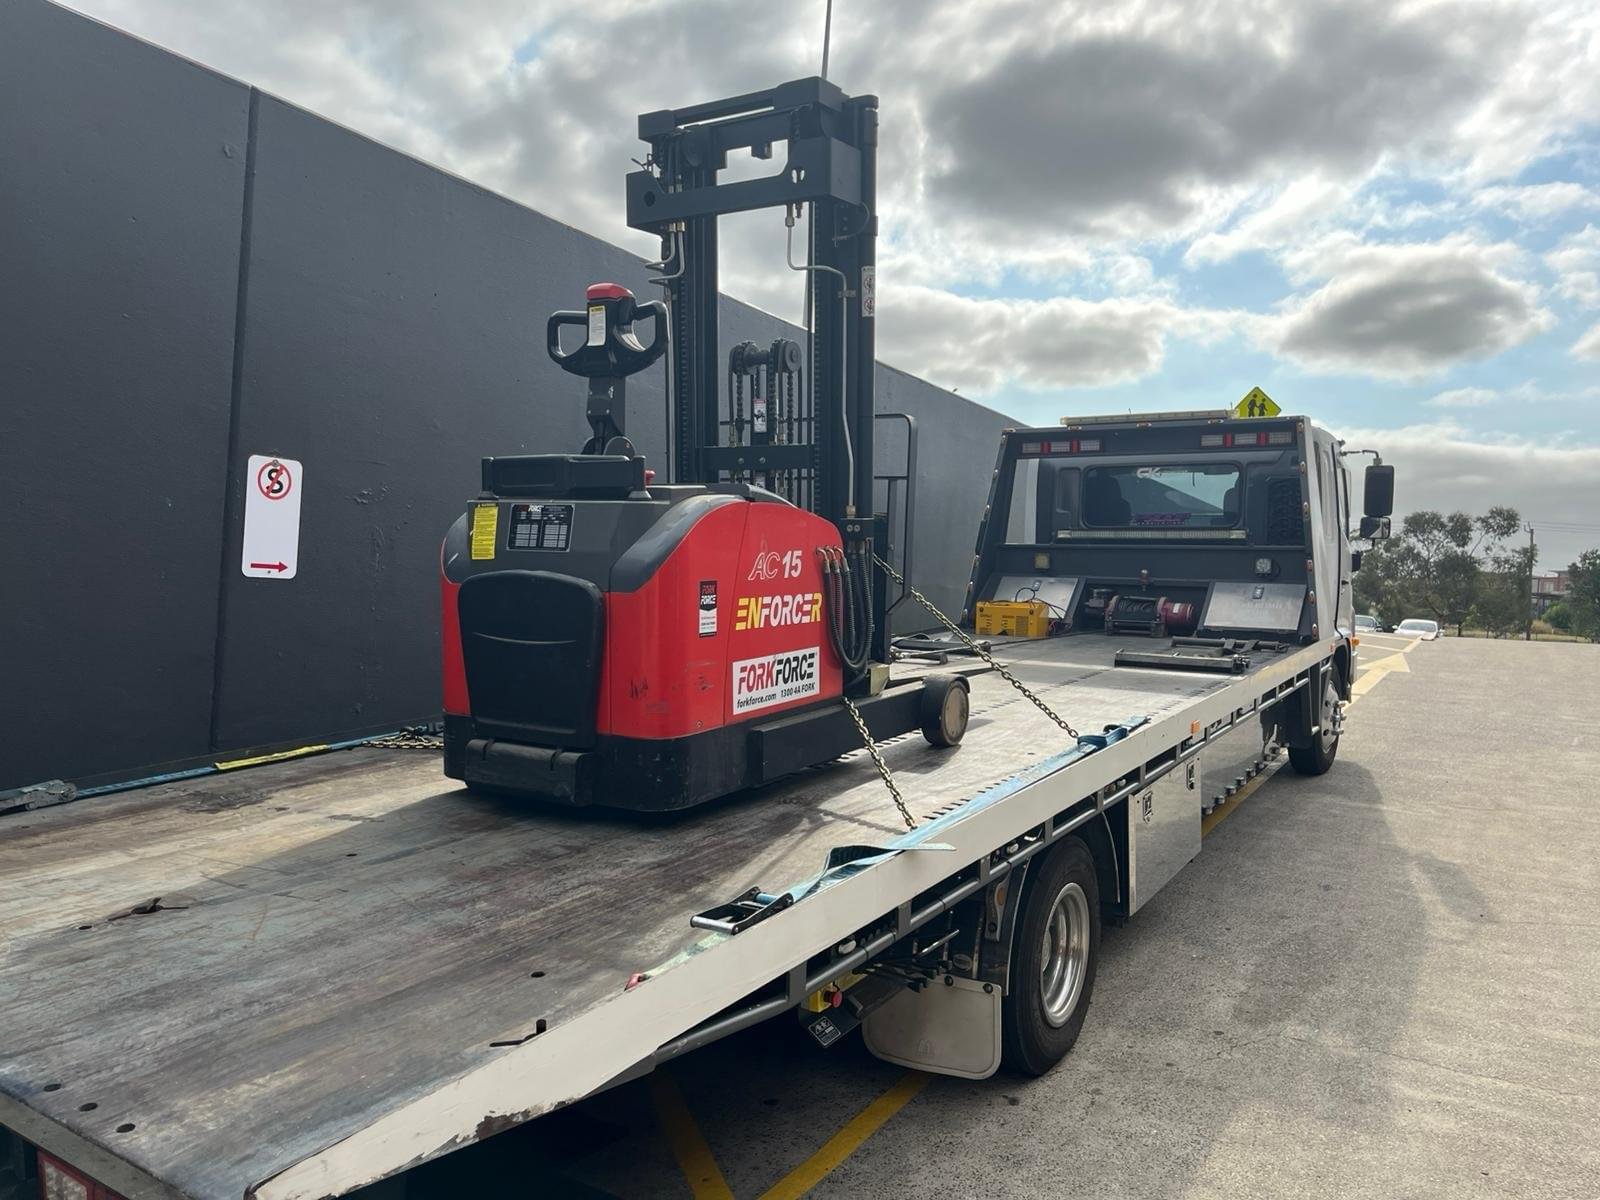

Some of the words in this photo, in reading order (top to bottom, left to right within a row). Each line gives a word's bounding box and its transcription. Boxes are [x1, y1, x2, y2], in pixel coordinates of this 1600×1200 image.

[747, 551, 780, 581] AC
[782, 550, 803, 579] 15
[735, 592, 823, 631] ENFORCER
[737, 652, 816, 695] FORKFORCE
[736, 693, 777, 709] forkforce.com
[780, 687, 793, 698] 1300
[801, 682, 816, 693] FORK
